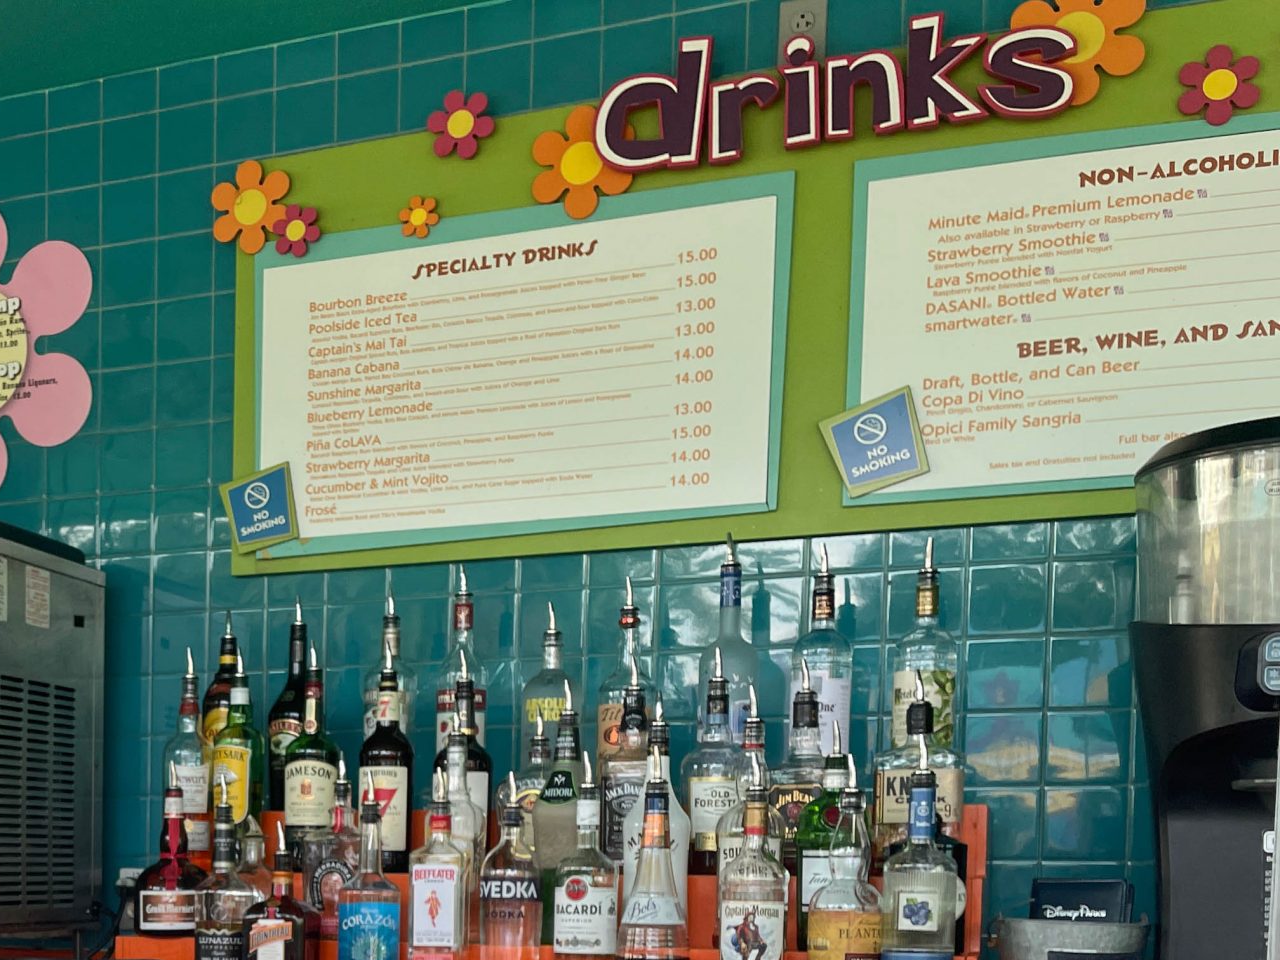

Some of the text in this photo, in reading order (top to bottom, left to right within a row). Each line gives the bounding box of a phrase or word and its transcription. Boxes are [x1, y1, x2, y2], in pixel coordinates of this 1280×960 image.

[595, 11, 1078, 168] drinks
[1079, 149, 1280, 188] NON-ALCOHOLI
[928, 212, 982, 230] Minute
[1031, 199, 1101, 217] Premium
[1107, 188, 1195, 210] Lemonade
[938, 210, 1161, 244] Also available in Strawberry or Raspberry
[677, 247, 718, 265] 15.00
[927, 231, 1096, 263] Strawberry Smoothie
[412, 239, 598, 280] SPECIALTY DRINKS
[676, 271, 717, 289] 15.00
[927, 264, 1042, 289] Lava Smoothie
[309, 290, 407, 313] Bourbon Breeze
[675, 296, 716, 314] 13.00
[925, 284, 1111, 315] DASANI Bottled Water
[308, 311, 417, 335] Poolside Iced Tea
[674, 321, 715, 339] 13.00
[924, 313, 1014, 334] smartwater
[308, 336, 407, 361] Captain's Mai Tai
[1017, 319, 1280, 359] BEER, WINE, AND SAN
[674, 345, 714, 362] 14.00
[308, 360, 400, 380] Banana Cabana
[675, 369, 713, 385] 14.00
[923, 359, 1140, 392] Draft, Bottle, and Can Beer
[307, 379, 421, 402] Sunshine Margarita
[922, 387, 1024, 410] Copa Di Vino
[307, 400, 433, 426] Blueberry Lemonade
[673, 400, 712, 416] 13.00
[672, 424, 712, 440] 15.00
[921, 410, 1081, 438] Opici Family Sangria
[306, 434, 381, 451] Piña CoLAVA
[867, 445, 888, 460] NO
[306, 451, 430, 475] Strawberry Margarita
[671, 448, 710, 464] 14.00
[852, 448, 911, 477] SMOKING
[305, 472, 449, 496] Cucumber & Mint Vojito
[670, 472, 709, 488] 14.00
[253, 510, 269, 521] NO
[305, 502, 337, 517] Frosé
[240, 515, 286, 536] SMOKING
[525, 697, 568, 711] ABSOLU
[286, 765, 333, 781] JAMESON
[544, 787, 573, 798] MIDORI
[414, 867, 455, 881] BEEFEATER
[556, 902, 602, 916] BACARDÍ
[724, 904, 780, 918] Captain Morgan
[198, 936, 242, 945] LUNAZUL
